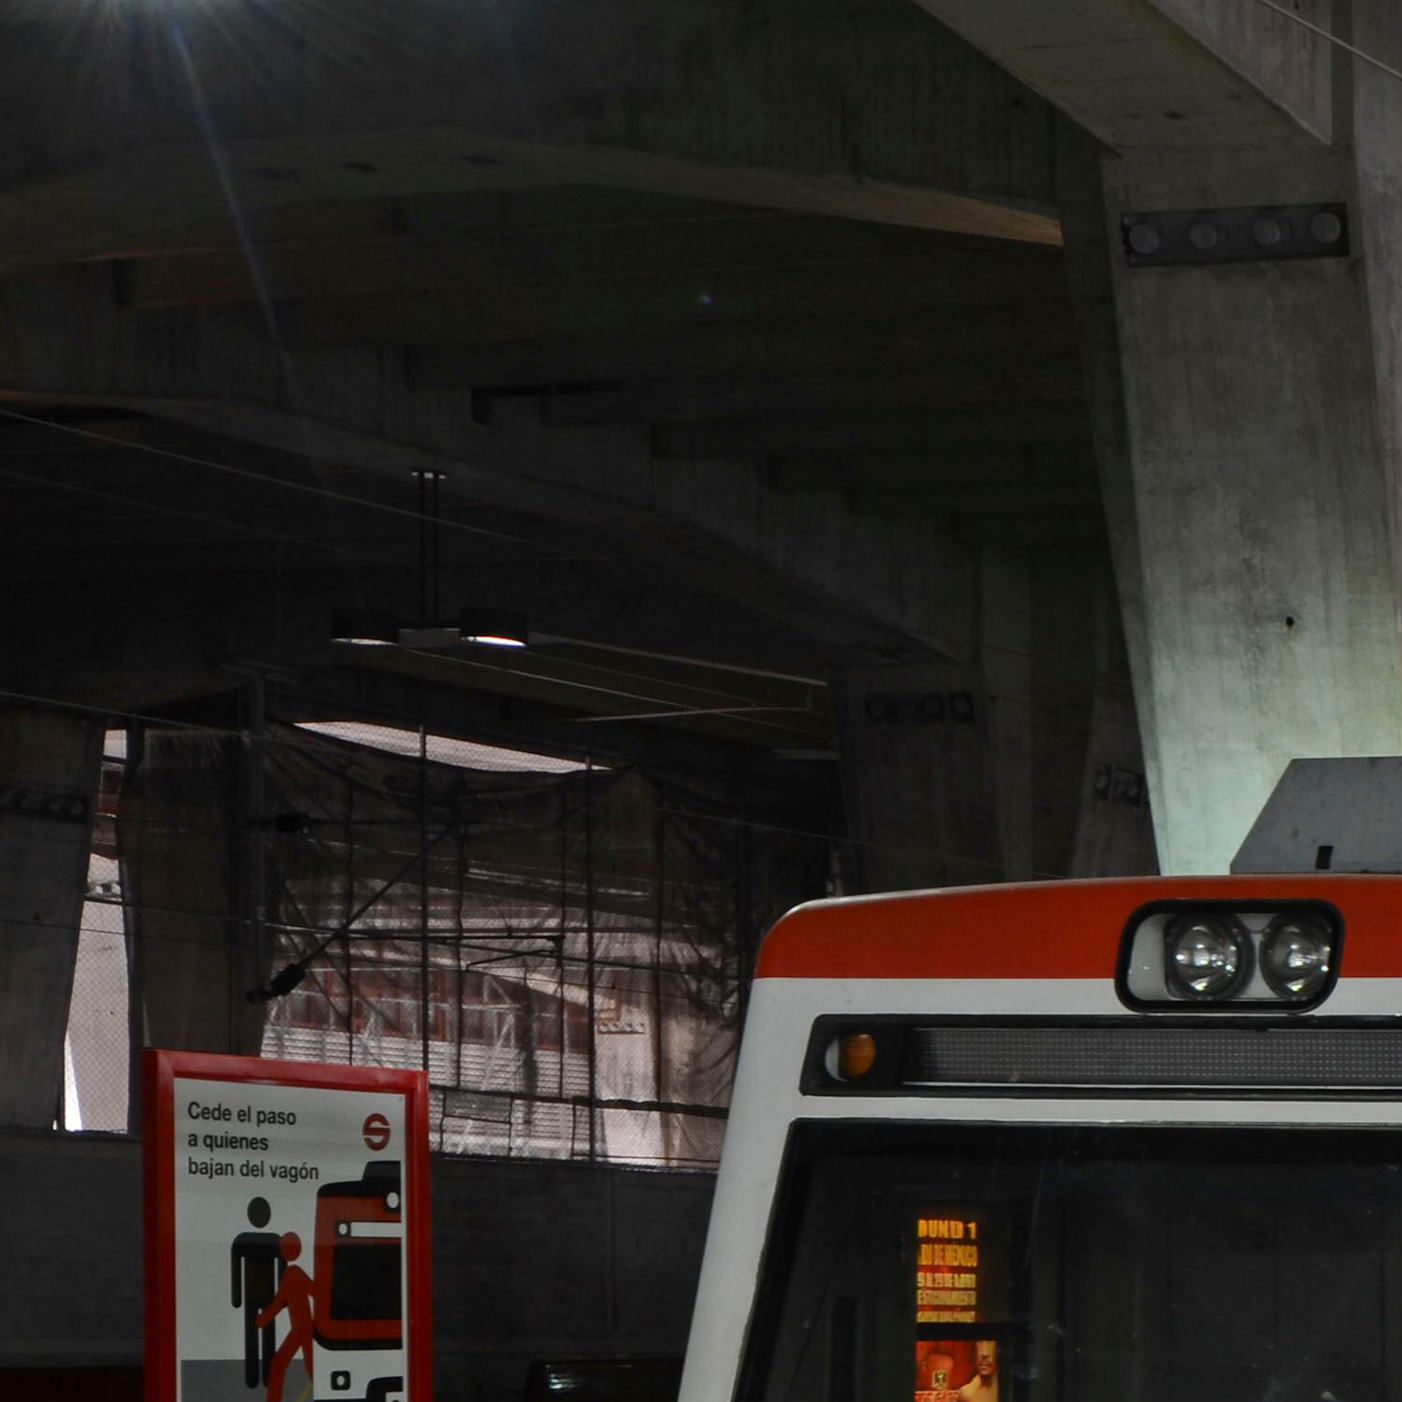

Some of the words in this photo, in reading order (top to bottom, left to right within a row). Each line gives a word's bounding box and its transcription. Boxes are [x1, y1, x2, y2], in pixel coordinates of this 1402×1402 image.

[188, 1101, 232, 1121] Cede
[237, 1105, 251, 1122] el
[256, 1110, 296, 1127] paso
[187, 1133, 198, 1147] a
[203, 1131, 269, 1152] quienes
[188, 1157, 234, 1179] bajan
[239, 1160, 264, 1178] del
[270, 1162, 319, 1183] vagón
